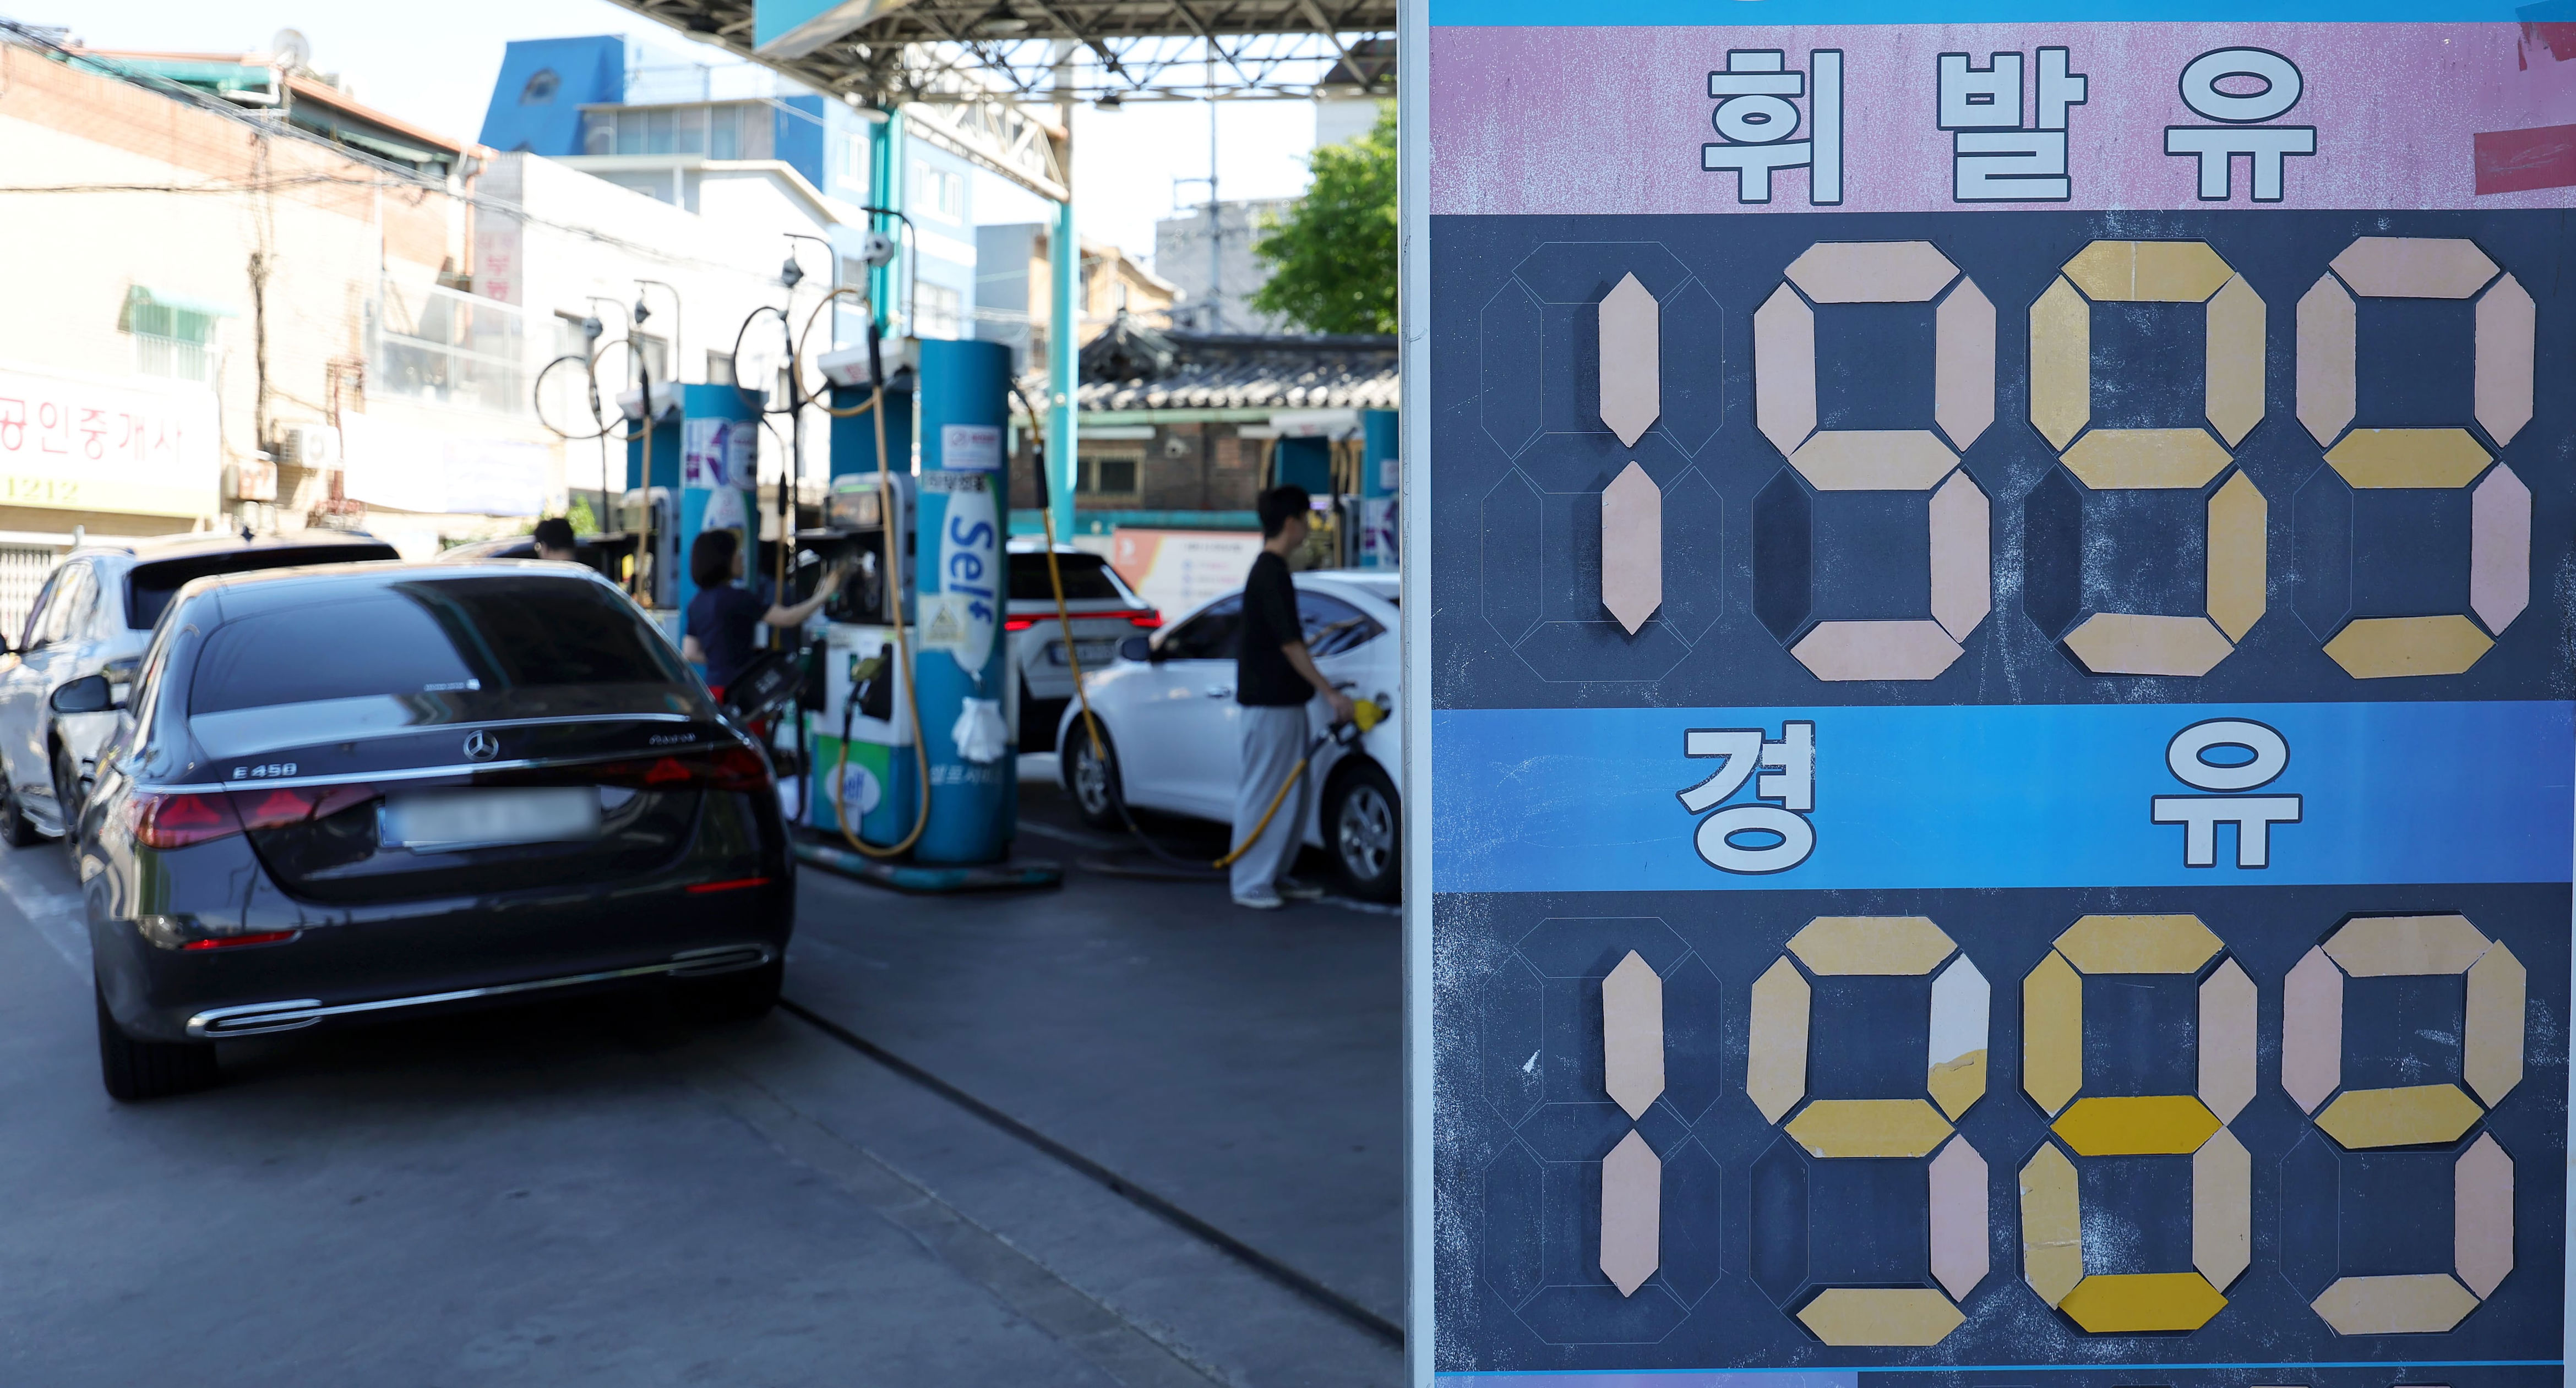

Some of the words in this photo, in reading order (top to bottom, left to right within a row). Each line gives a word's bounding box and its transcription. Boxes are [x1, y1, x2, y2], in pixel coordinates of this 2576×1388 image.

[1701, 46, 2317, 205] 휘발유
[0, 396, 182, 465] 공인중개사
[1599, 236, 2536, 681] 1999
[950, 515, 994, 625] Self
[233, 766, 248, 779] E
[250, 763, 297, 778] 450
[1676, 719, 2302, 874] 경유
[1600, 914, 2526, 1346] 1989
